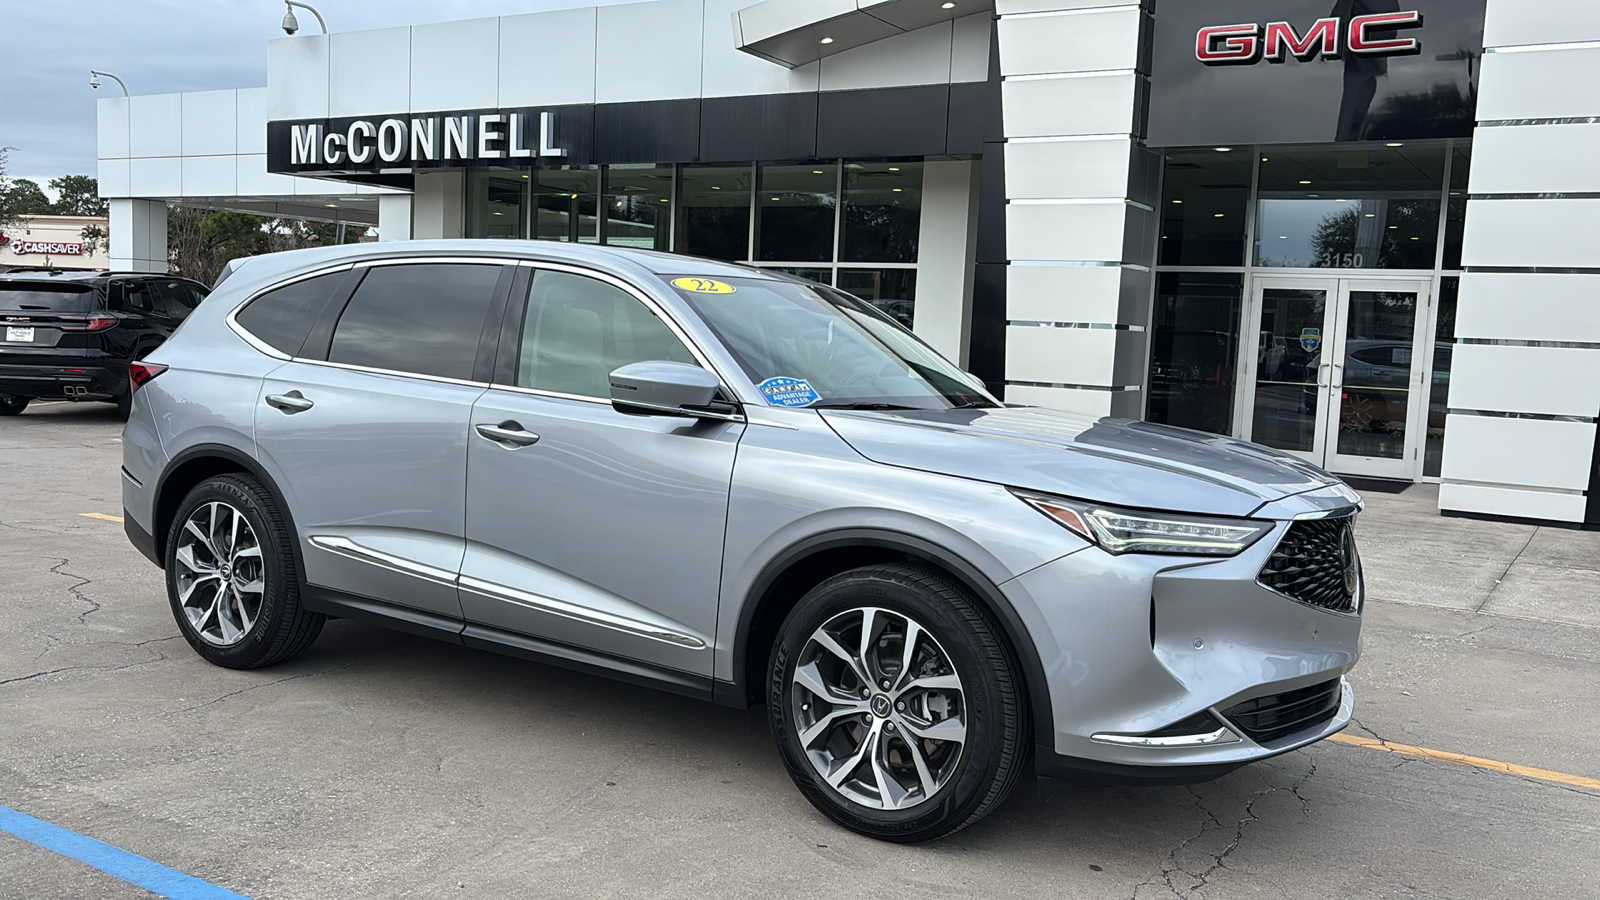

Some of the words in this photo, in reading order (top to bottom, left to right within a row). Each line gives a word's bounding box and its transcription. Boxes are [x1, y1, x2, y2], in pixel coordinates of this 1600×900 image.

[1195, 10, 1422, 65] GMC
[290, 111, 568, 165] McCONNELL
[24, 242, 80, 254] CASHSAVER
[1321, 252, 1364, 268] 3150
[690, 278, 719, 292] 22
[772, 390, 812, 401] ADVANTAGE
[782, 397, 810, 406] DEALER
[216, 483, 250, 506] ALENZA
[254, 578, 276, 642] IDGESTONE
[773, 644, 790, 747] ASSURANCE
